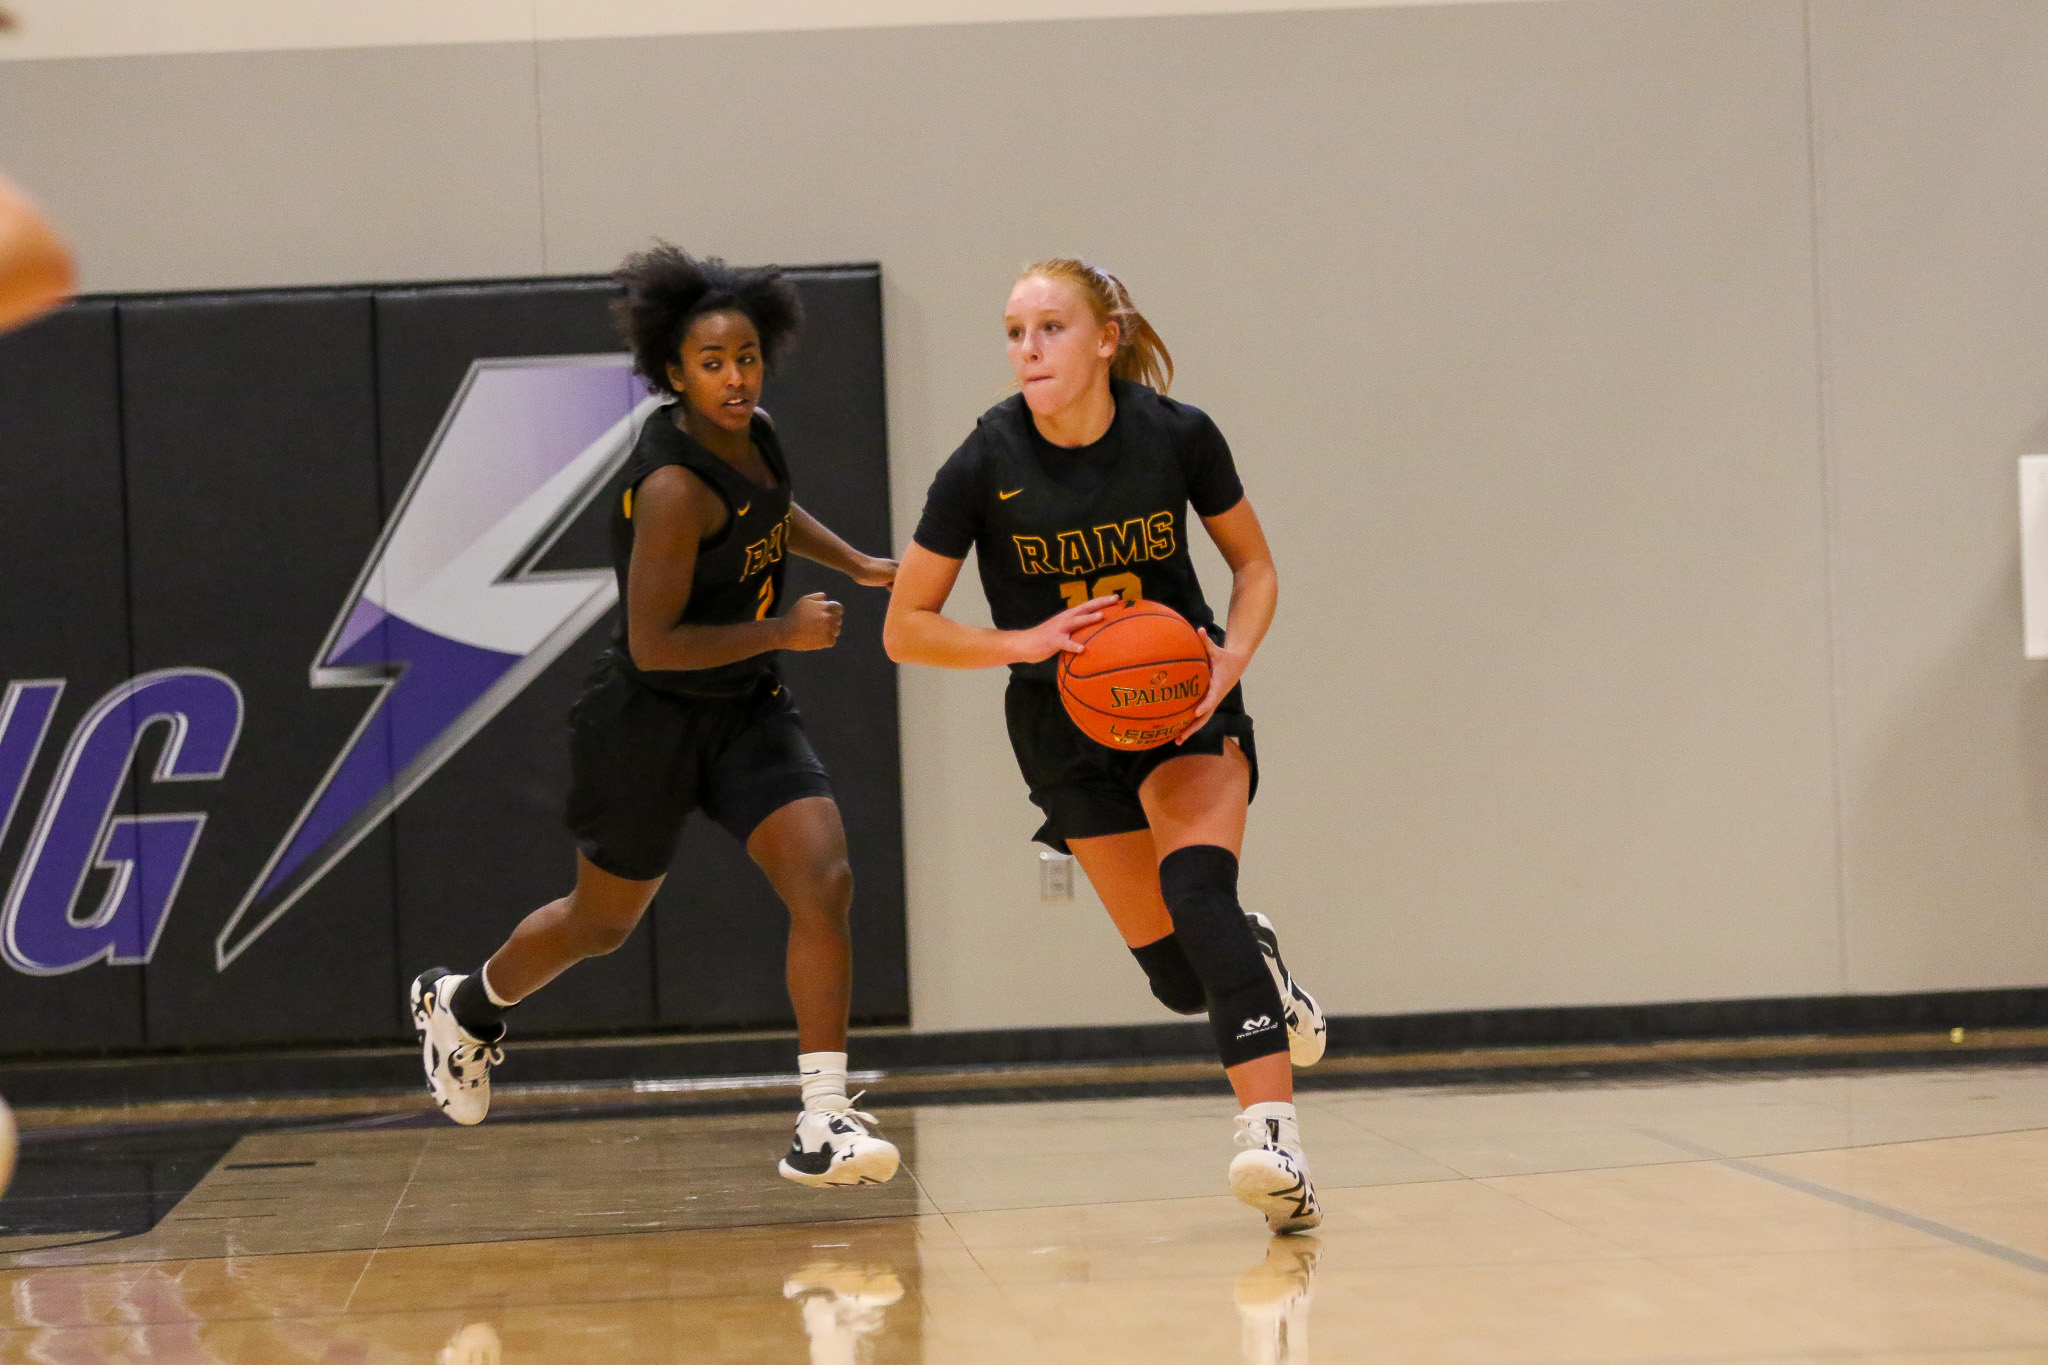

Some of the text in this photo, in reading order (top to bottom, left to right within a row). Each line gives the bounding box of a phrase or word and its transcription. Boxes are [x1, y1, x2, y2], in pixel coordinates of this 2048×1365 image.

[1012, 511, 1176, 575] RAMS
[1110, 674, 1200, 709] SPALDING
[1109, 719, 1192, 740] LEGAC
